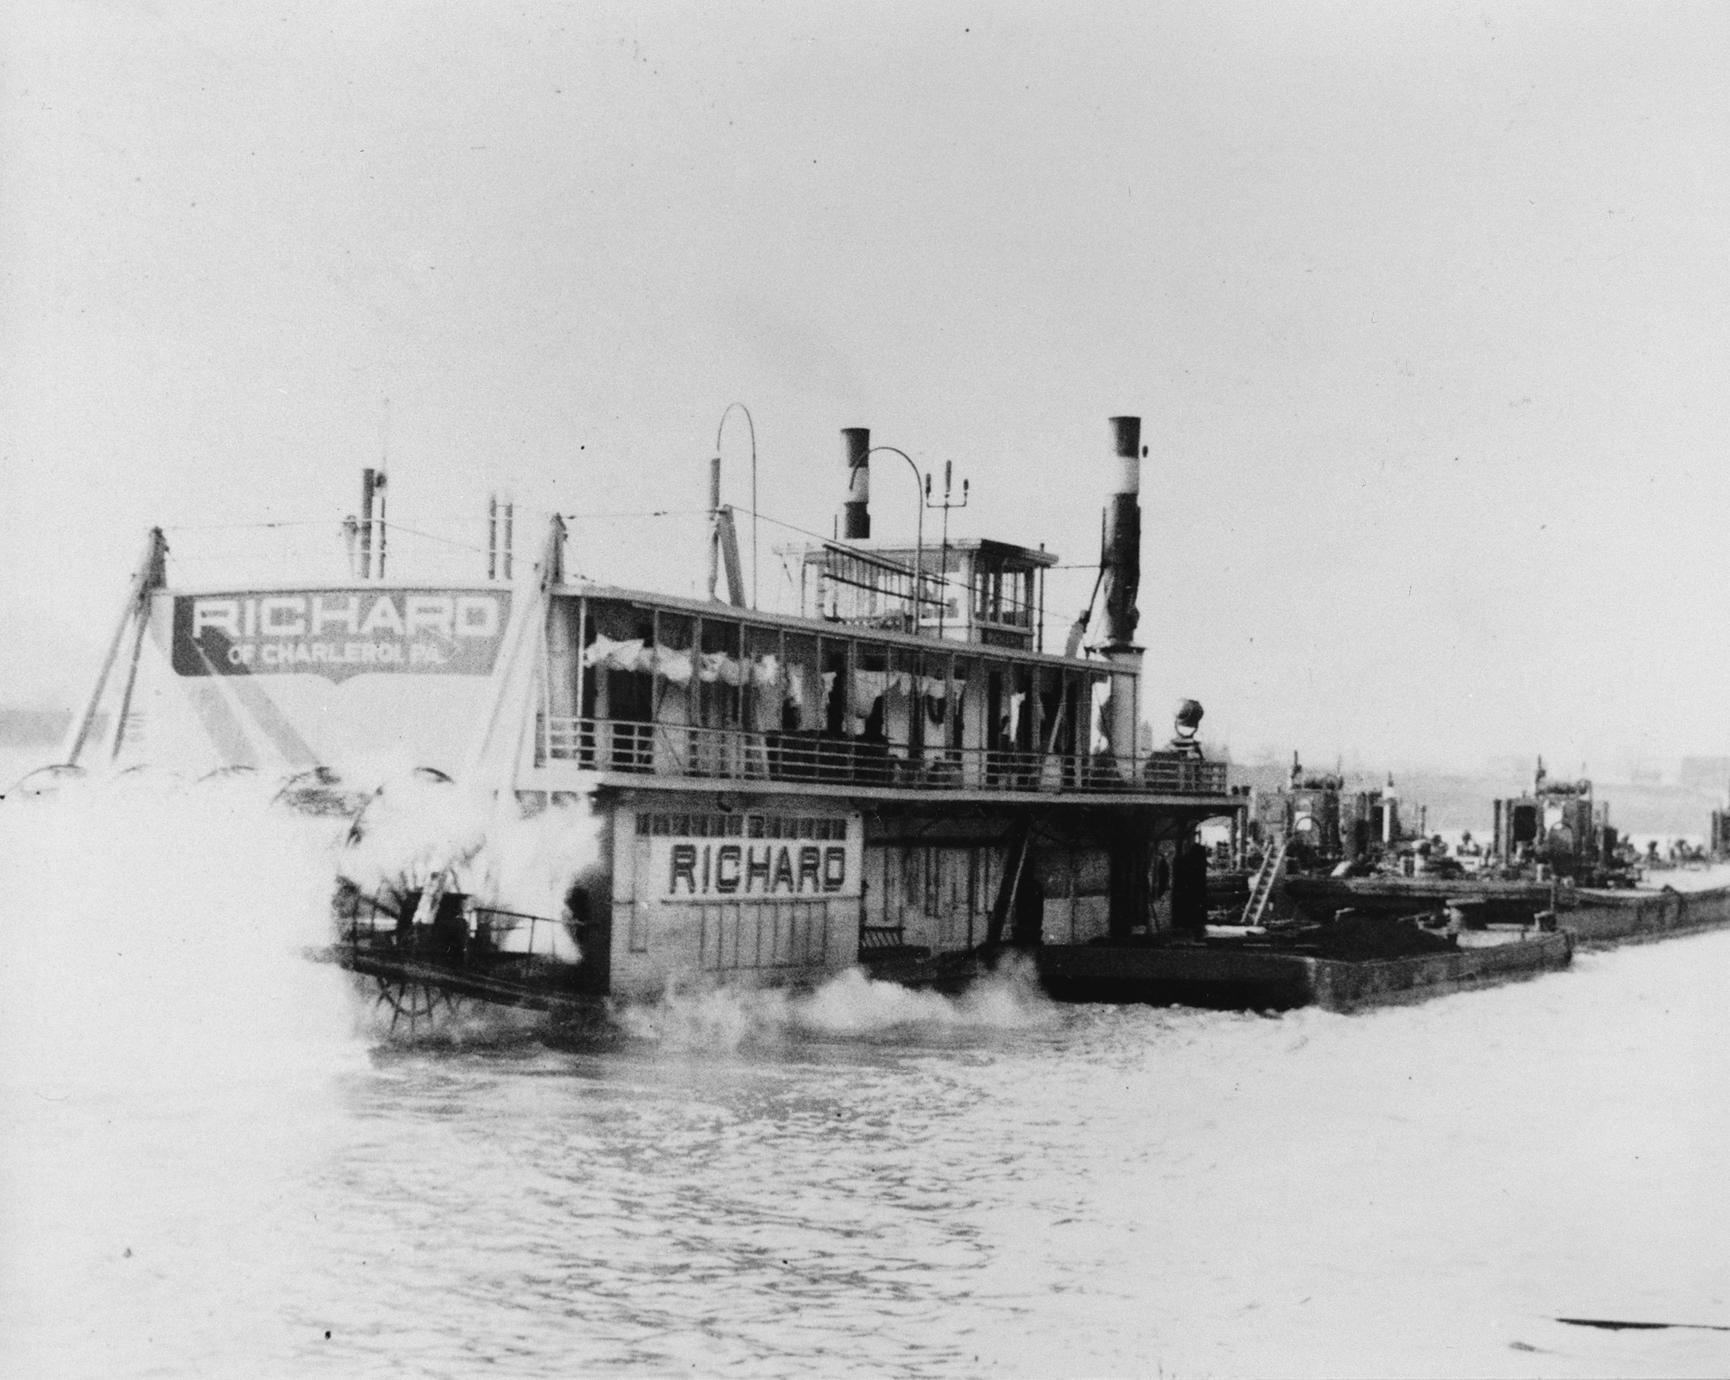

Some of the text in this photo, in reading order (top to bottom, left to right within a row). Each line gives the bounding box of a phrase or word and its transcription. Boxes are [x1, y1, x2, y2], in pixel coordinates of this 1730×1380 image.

[193, 595, 499, 638] RICHARD
[227, 644, 256, 665] OF
[669, 844, 846, 894] RICHARD
